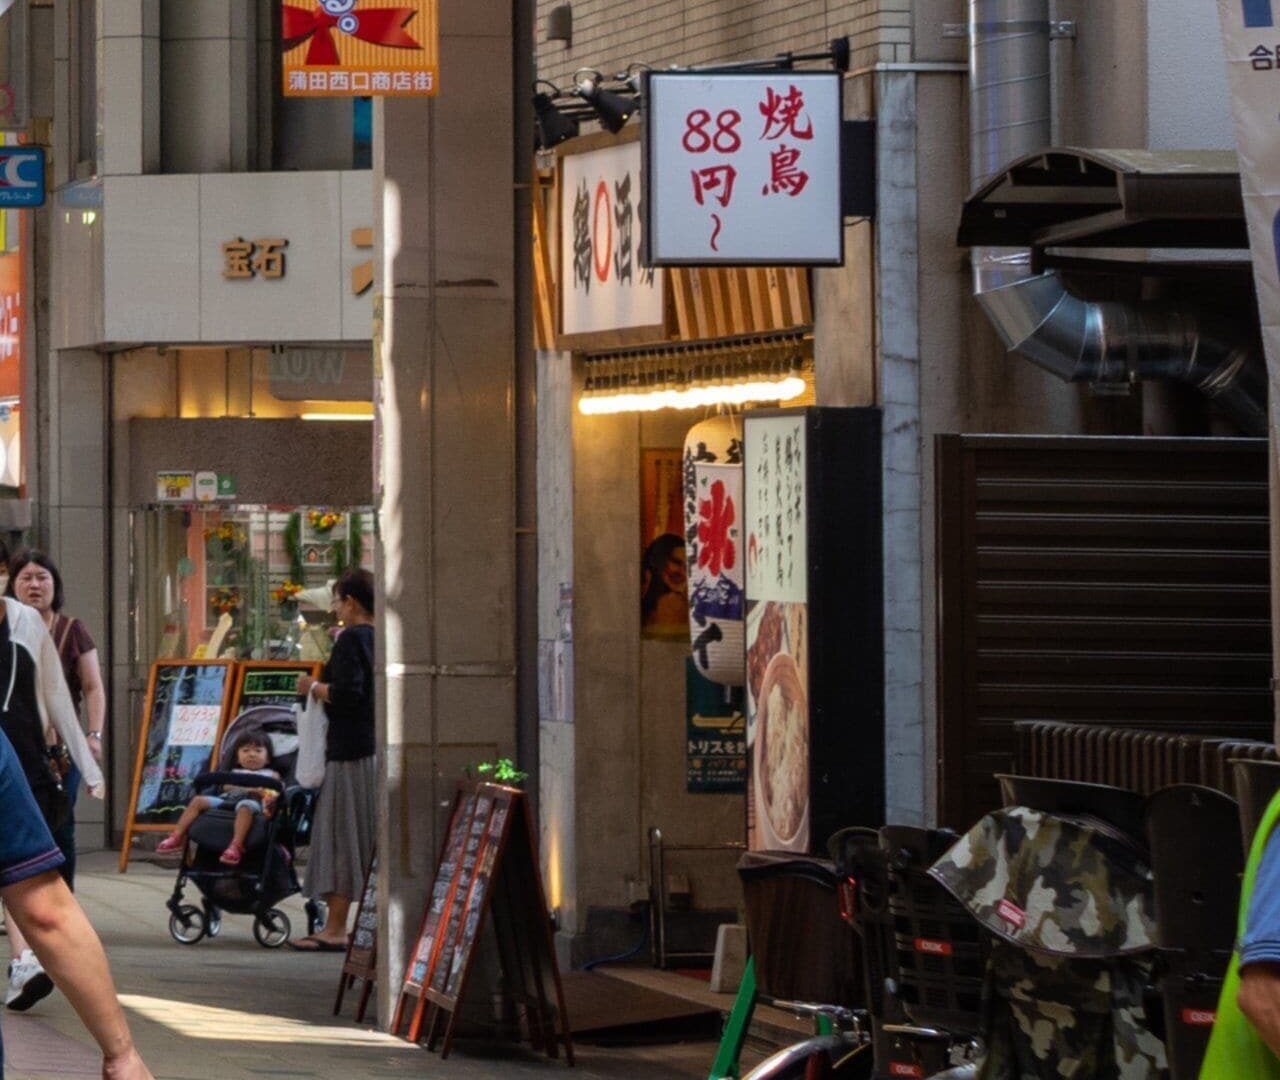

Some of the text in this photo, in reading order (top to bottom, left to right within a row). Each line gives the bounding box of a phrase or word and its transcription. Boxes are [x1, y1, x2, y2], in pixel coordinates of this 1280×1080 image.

[288, 69, 434, 92] 蒲田西口商店街
[758, 84, 814, 198] 焼鳥
[221, 236, 289, 280] 宝石
